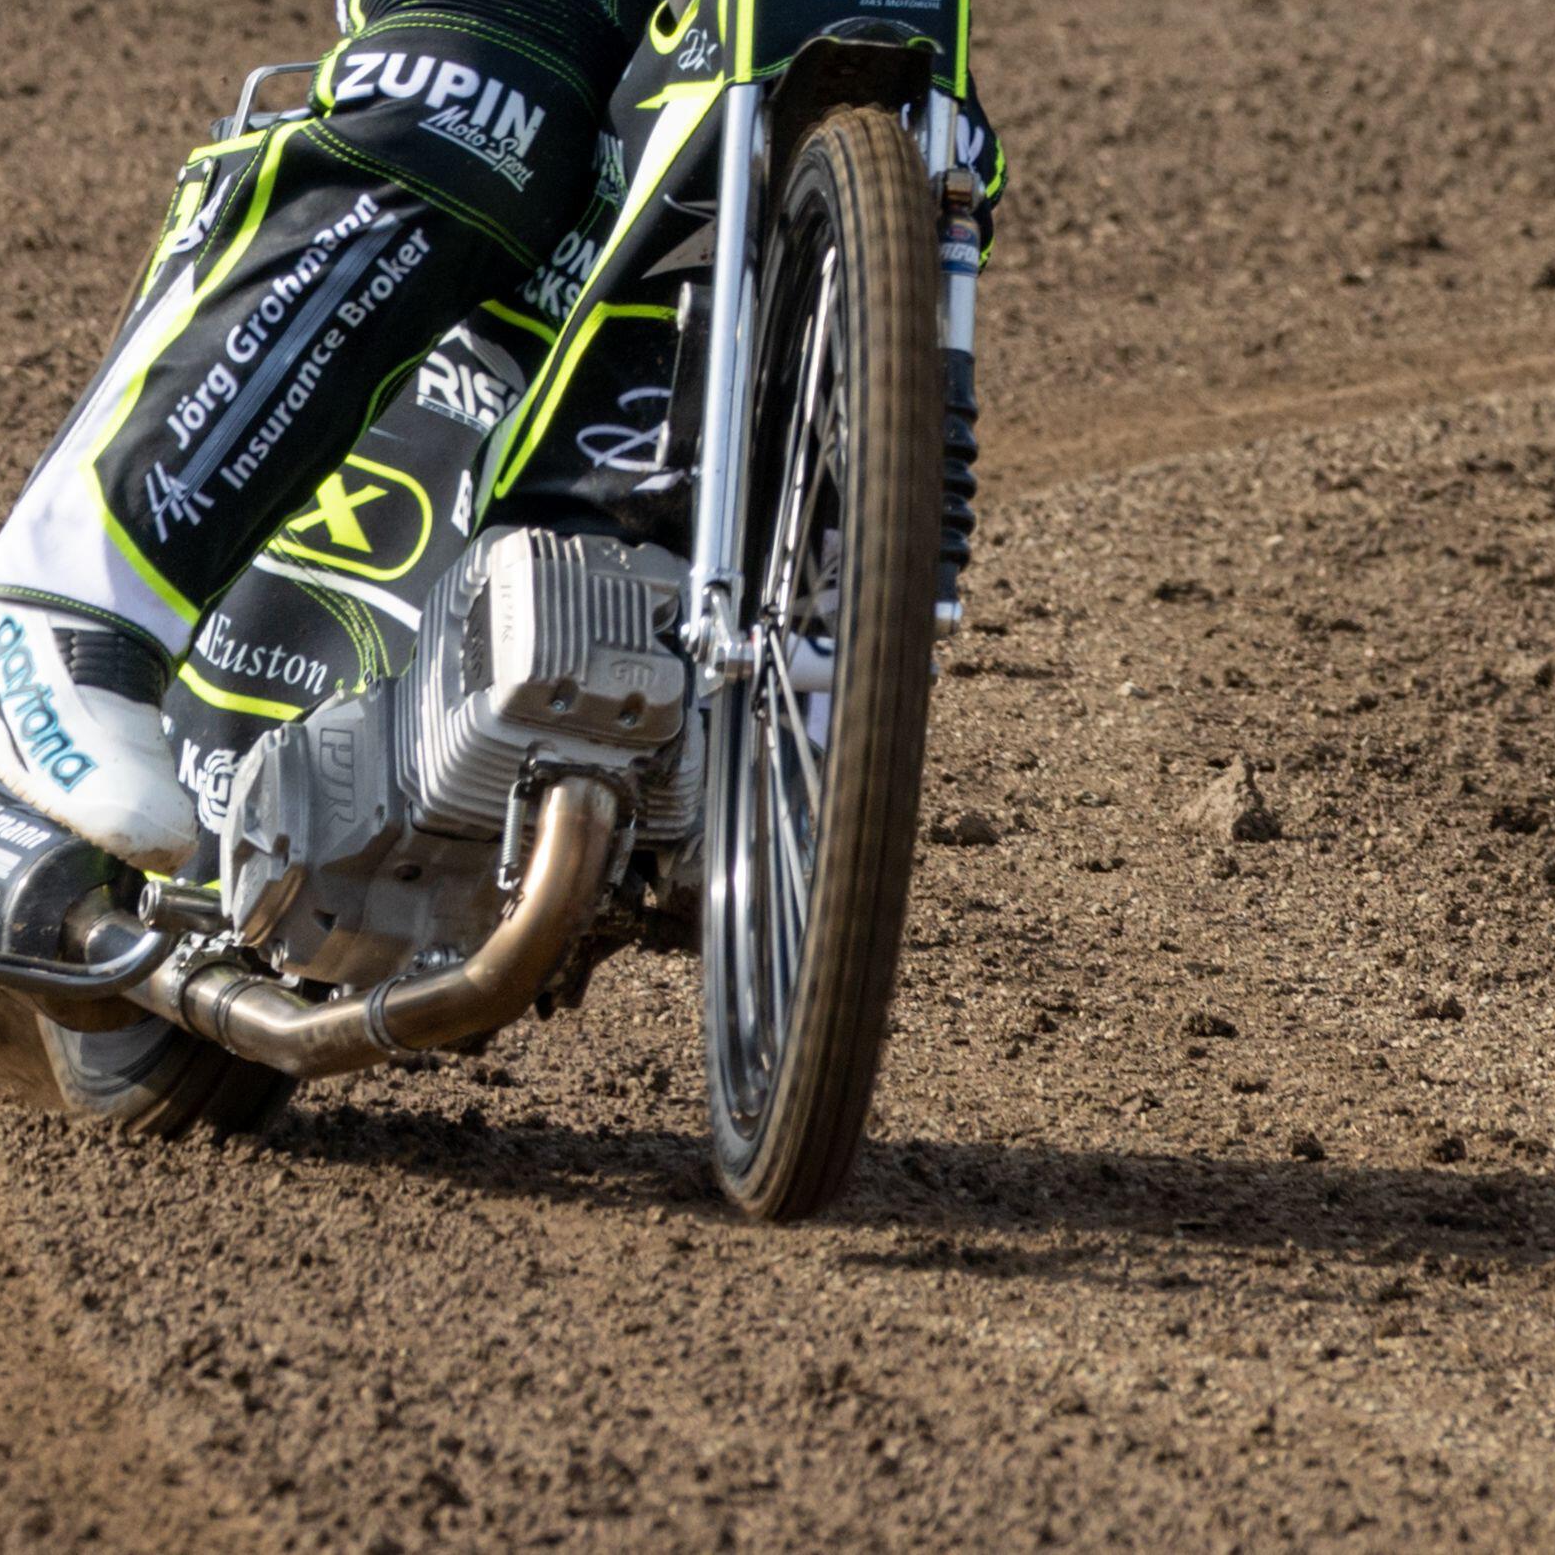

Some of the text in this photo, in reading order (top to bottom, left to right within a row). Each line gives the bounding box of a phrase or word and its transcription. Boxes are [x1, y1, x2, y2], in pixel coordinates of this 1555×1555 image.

[335, 51, 546, 156] ZUPIN
[163, 378, 240, 451] Jörg
[224, 192, 382, 367] Grohmann
[219, 226, 432, 491] Insurance Broker
[208, 610, 330, 697] Euston
